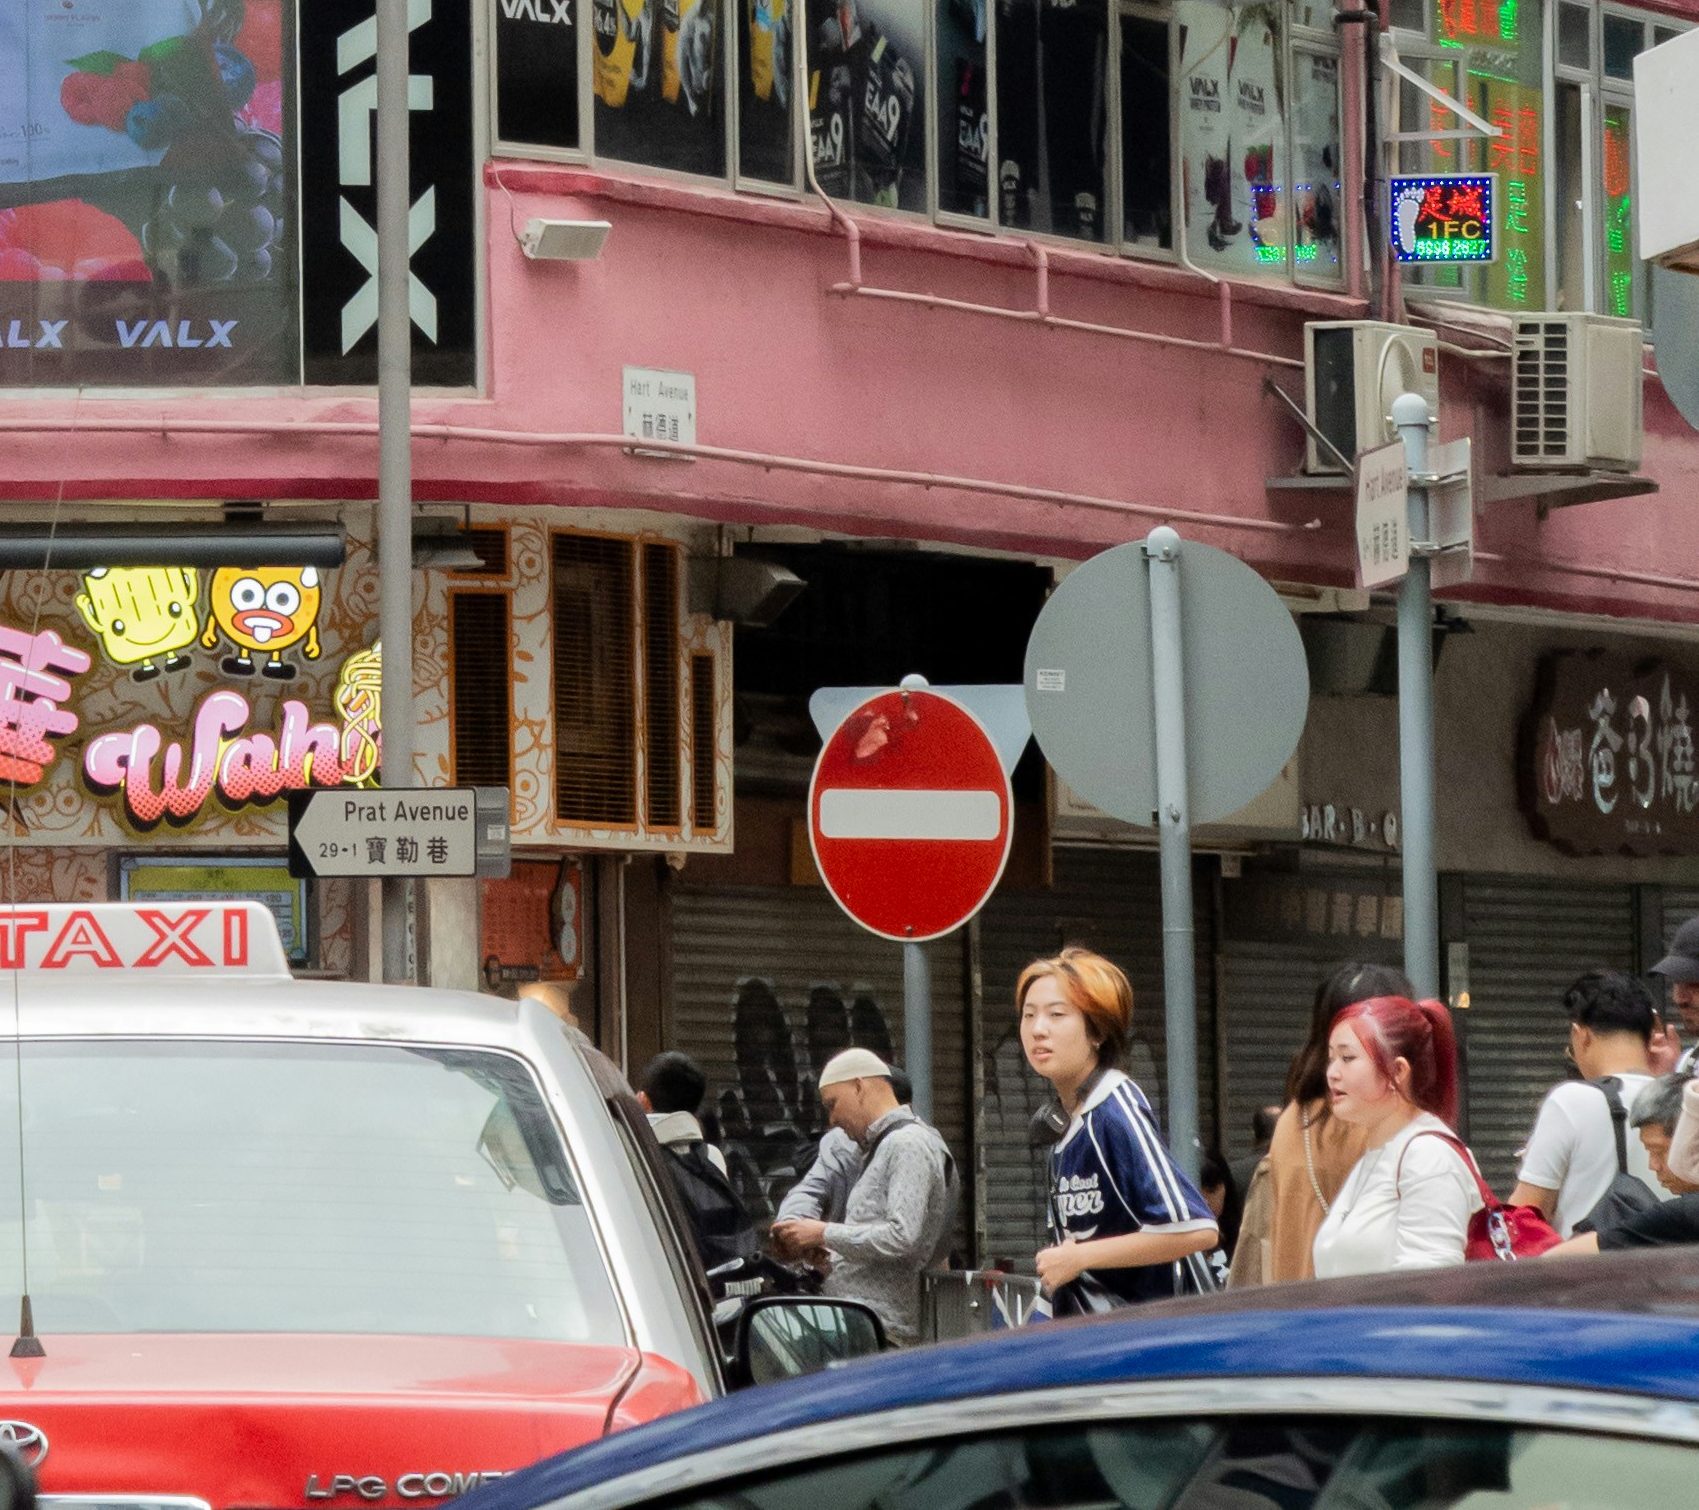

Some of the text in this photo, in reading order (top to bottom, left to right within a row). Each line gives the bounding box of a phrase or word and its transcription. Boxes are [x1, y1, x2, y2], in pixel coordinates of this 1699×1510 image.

[864, 81, 901, 142] EAA9
[1428, 220, 1481, 239] 1FC
[115, 320, 239, 349] VALX
[630, 379, 688, 401] Hart Avenue
[345, 801, 469, 822] Prat Avenue
[366, 836, 449, 865] 寶勒巷
[305, 1474, 387, 1500] LPG
